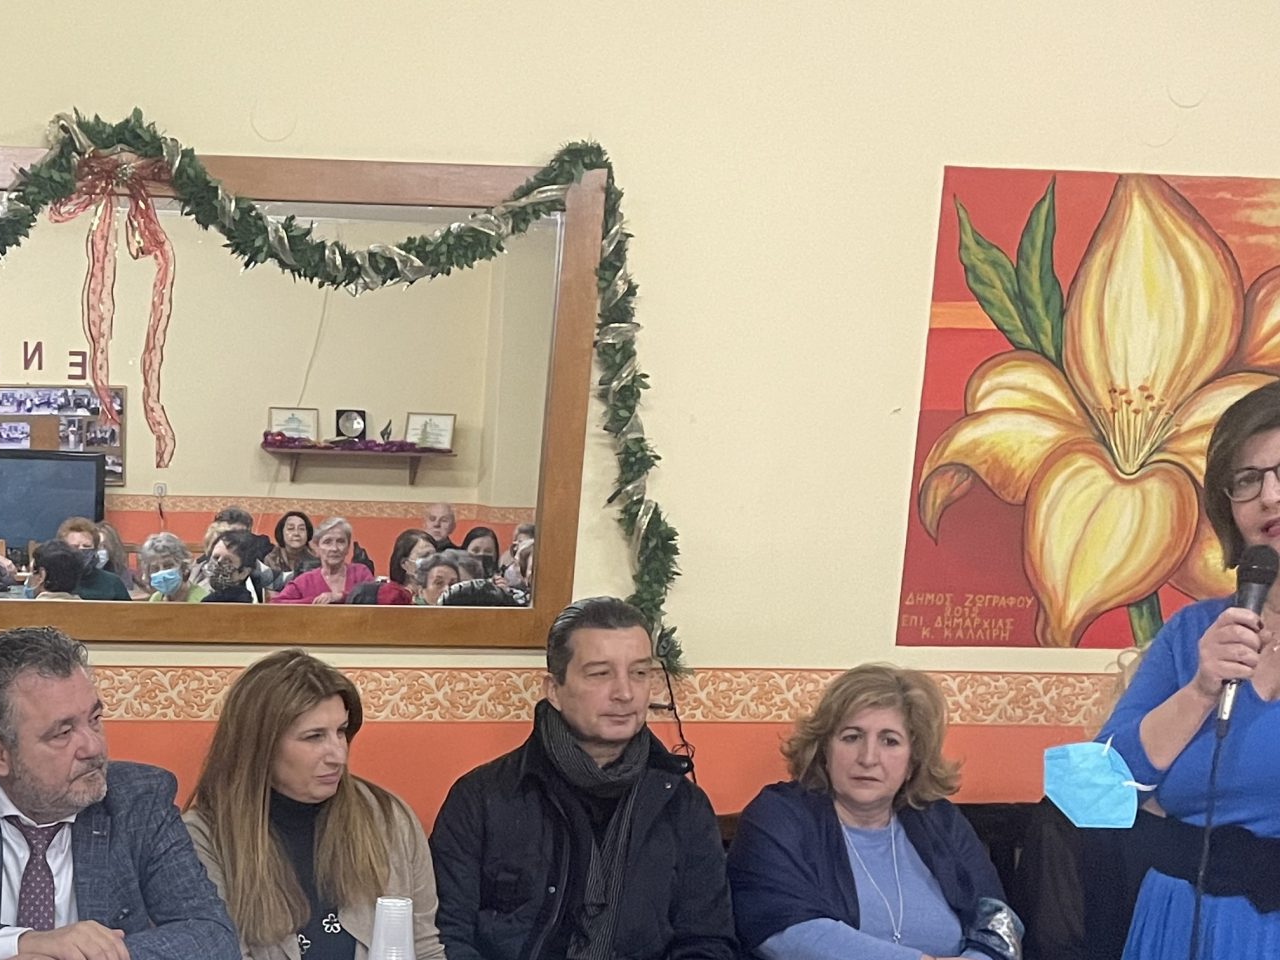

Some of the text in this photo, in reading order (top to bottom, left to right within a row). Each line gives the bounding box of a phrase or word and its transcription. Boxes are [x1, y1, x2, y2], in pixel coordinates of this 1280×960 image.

[905, 592, 1034, 608] ΔΗΜΟΣ ΖΩΓΡΑΦΟΥ
[934, 616, 1015, 630] ΔΗΜΑΡΧΙΑΣ
[922, 627, 934, 640] Κ.
